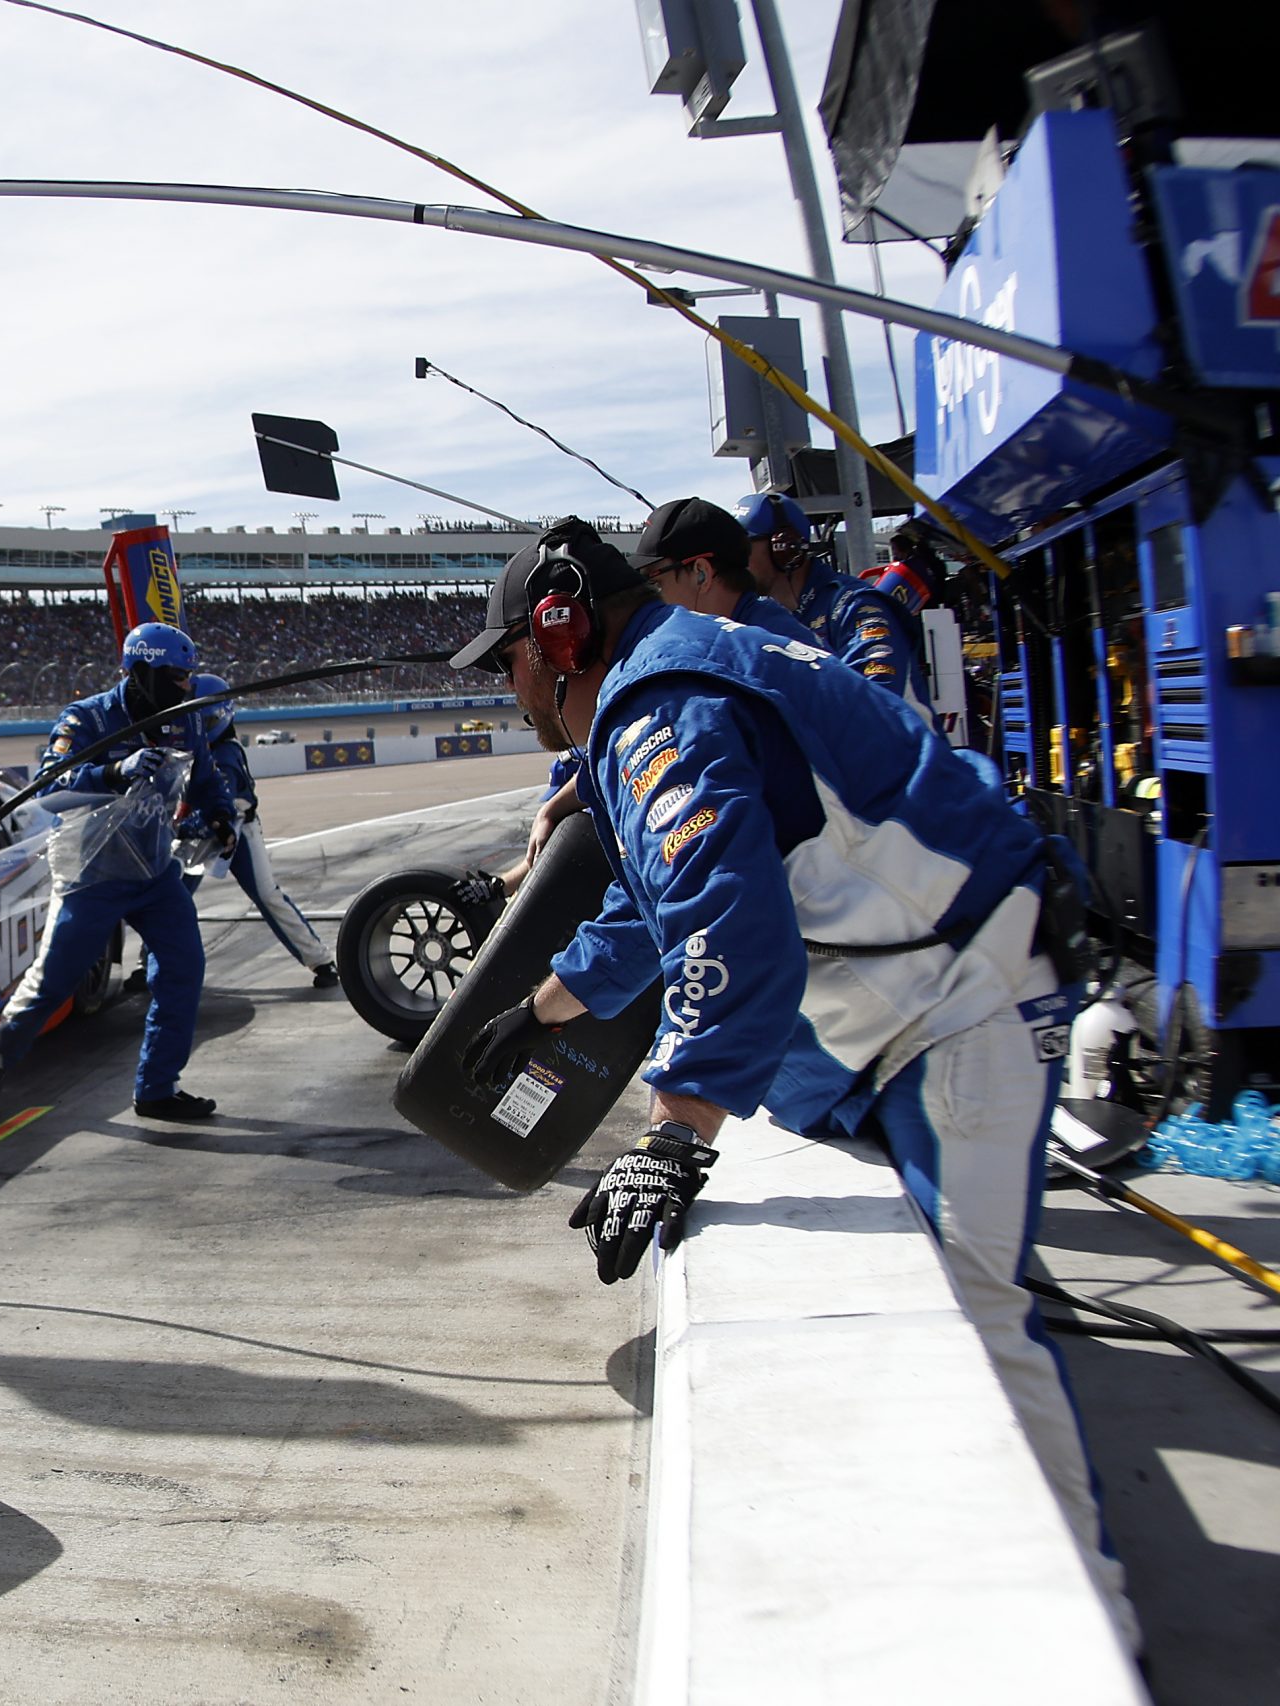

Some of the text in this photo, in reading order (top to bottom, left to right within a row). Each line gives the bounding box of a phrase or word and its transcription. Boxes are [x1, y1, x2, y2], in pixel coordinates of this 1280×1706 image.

[853, 491, 863, 507] 3
[152, 553, 179, 624] UNOCO
[132, 640, 166, 662] Kroger
[629, 726, 673, 769] NASCAR
[632, 749, 678, 803] Velveeta
[647, 783, 694, 831] Minute
[663, 808, 715, 863] Reese's
[525, 1077, 550, 1094] EAGLE
[528, 1060, 564, 1086] GOODYEAR
[595, 1170, 677, 1197] Mechanix
